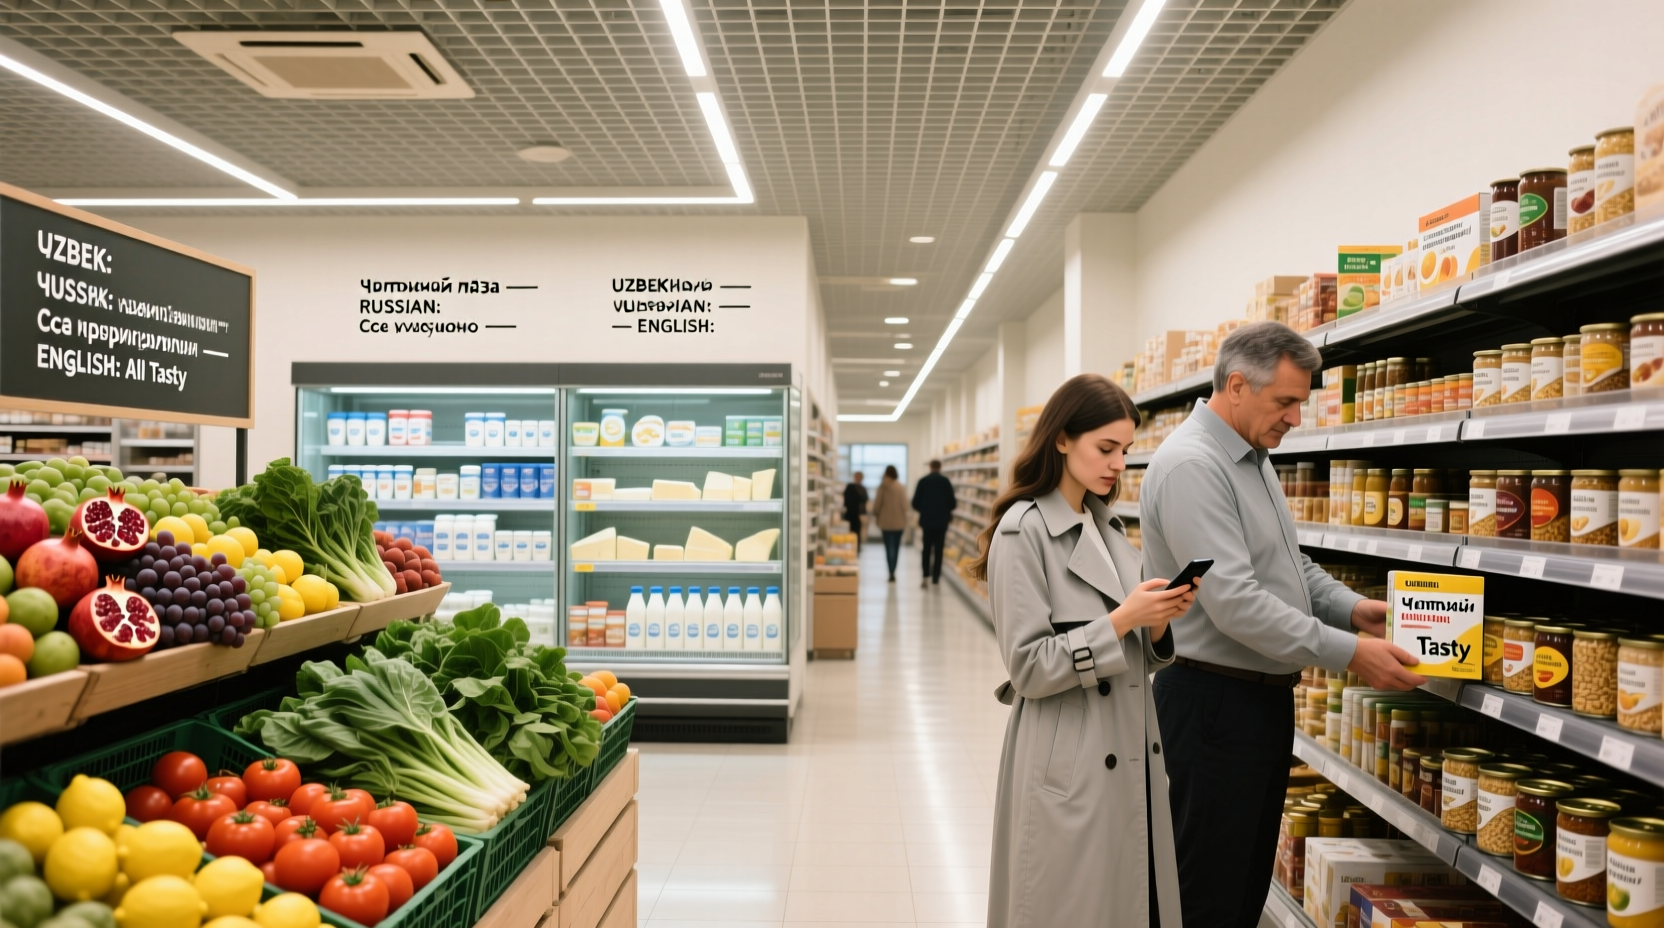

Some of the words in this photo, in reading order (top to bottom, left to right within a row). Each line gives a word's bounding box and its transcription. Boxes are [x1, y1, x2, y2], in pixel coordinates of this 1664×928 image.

[359, 299, 441, 314] RUSSIAN:
[637, 318, 715, 333] ENGLISH:
[37, 343, 121, 377] ENGLISH:
[125, 357, 146, 381] All
[149, 361, 188, 391] Tasty
[1416, 636, 1471, 664] Tasty
